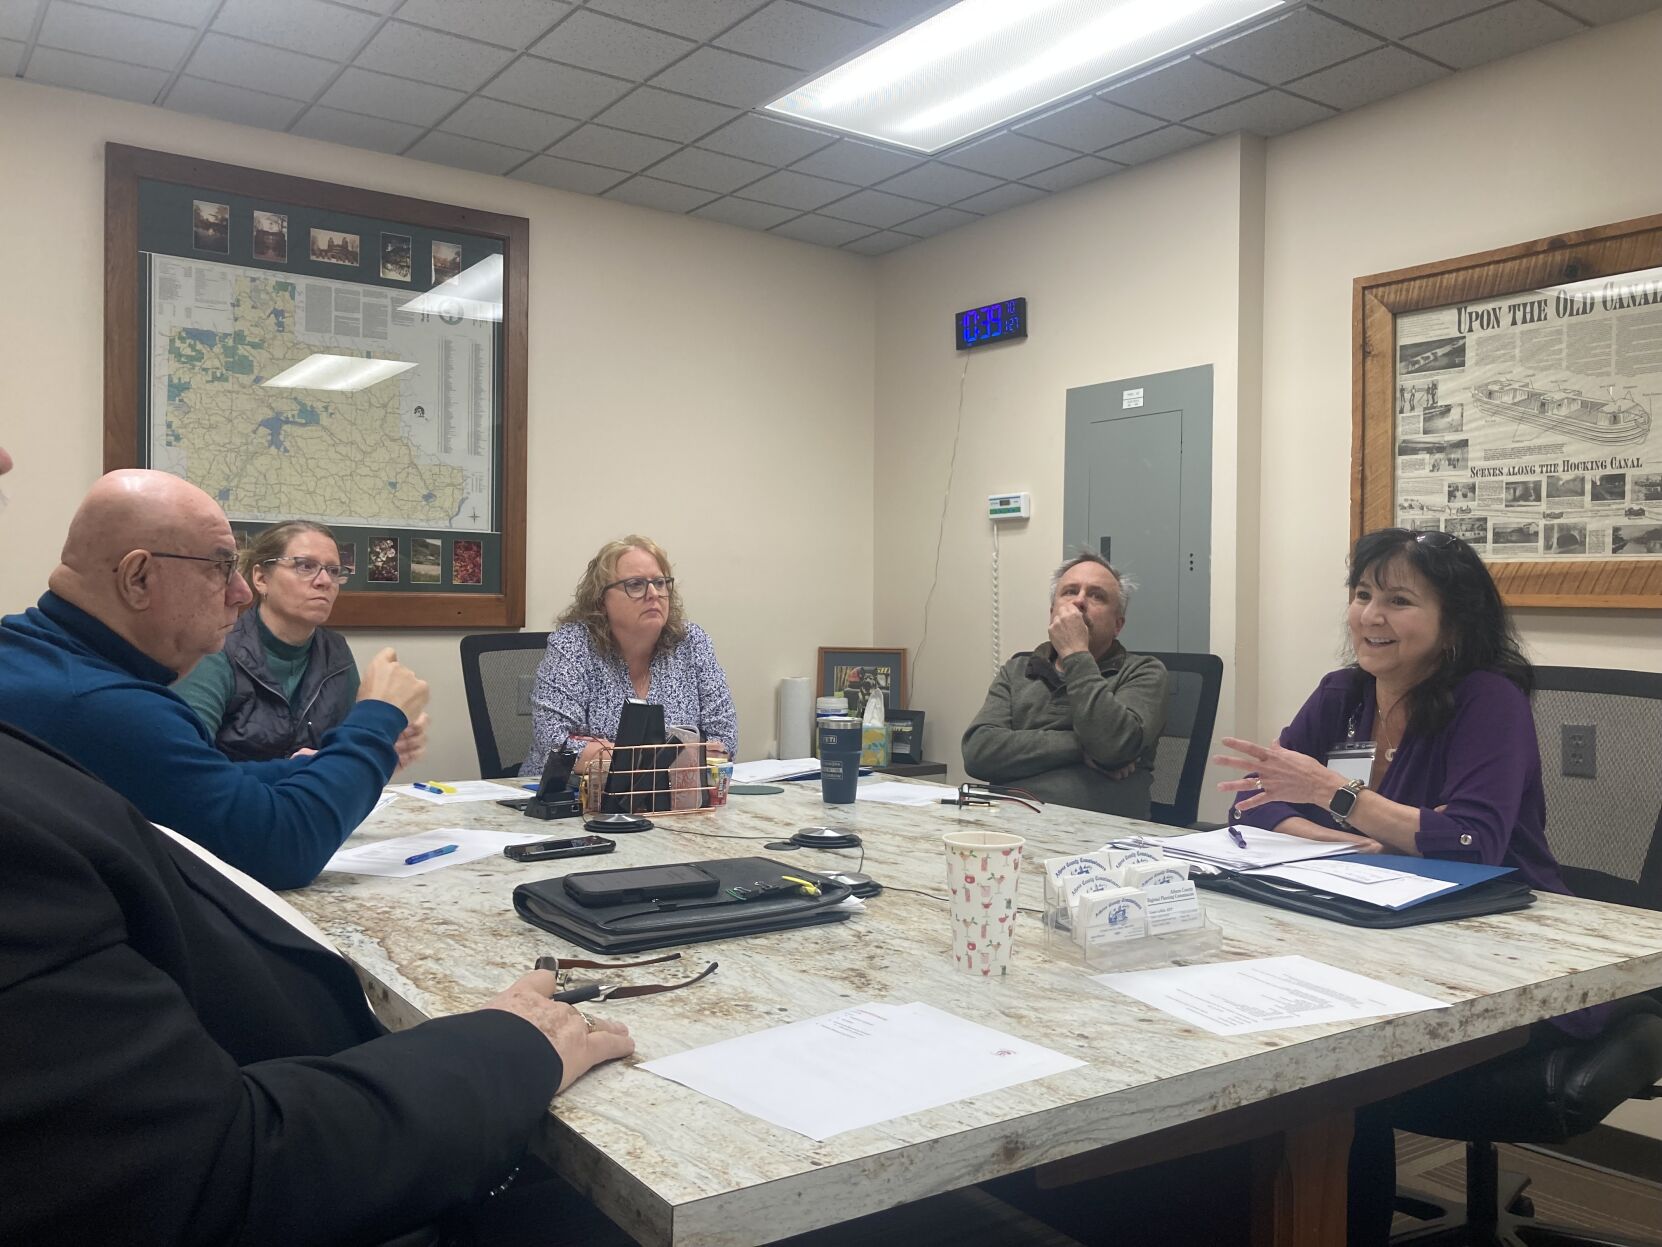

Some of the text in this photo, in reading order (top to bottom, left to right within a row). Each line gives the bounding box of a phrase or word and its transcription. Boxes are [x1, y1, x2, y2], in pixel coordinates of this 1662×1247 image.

[1457, 304, 1502, 334] UPON
[1508, 298, 1548, 327] THE
[1555, 288, 1596, 319] OLD
[1610, 456, 1643, 470] CANAL
